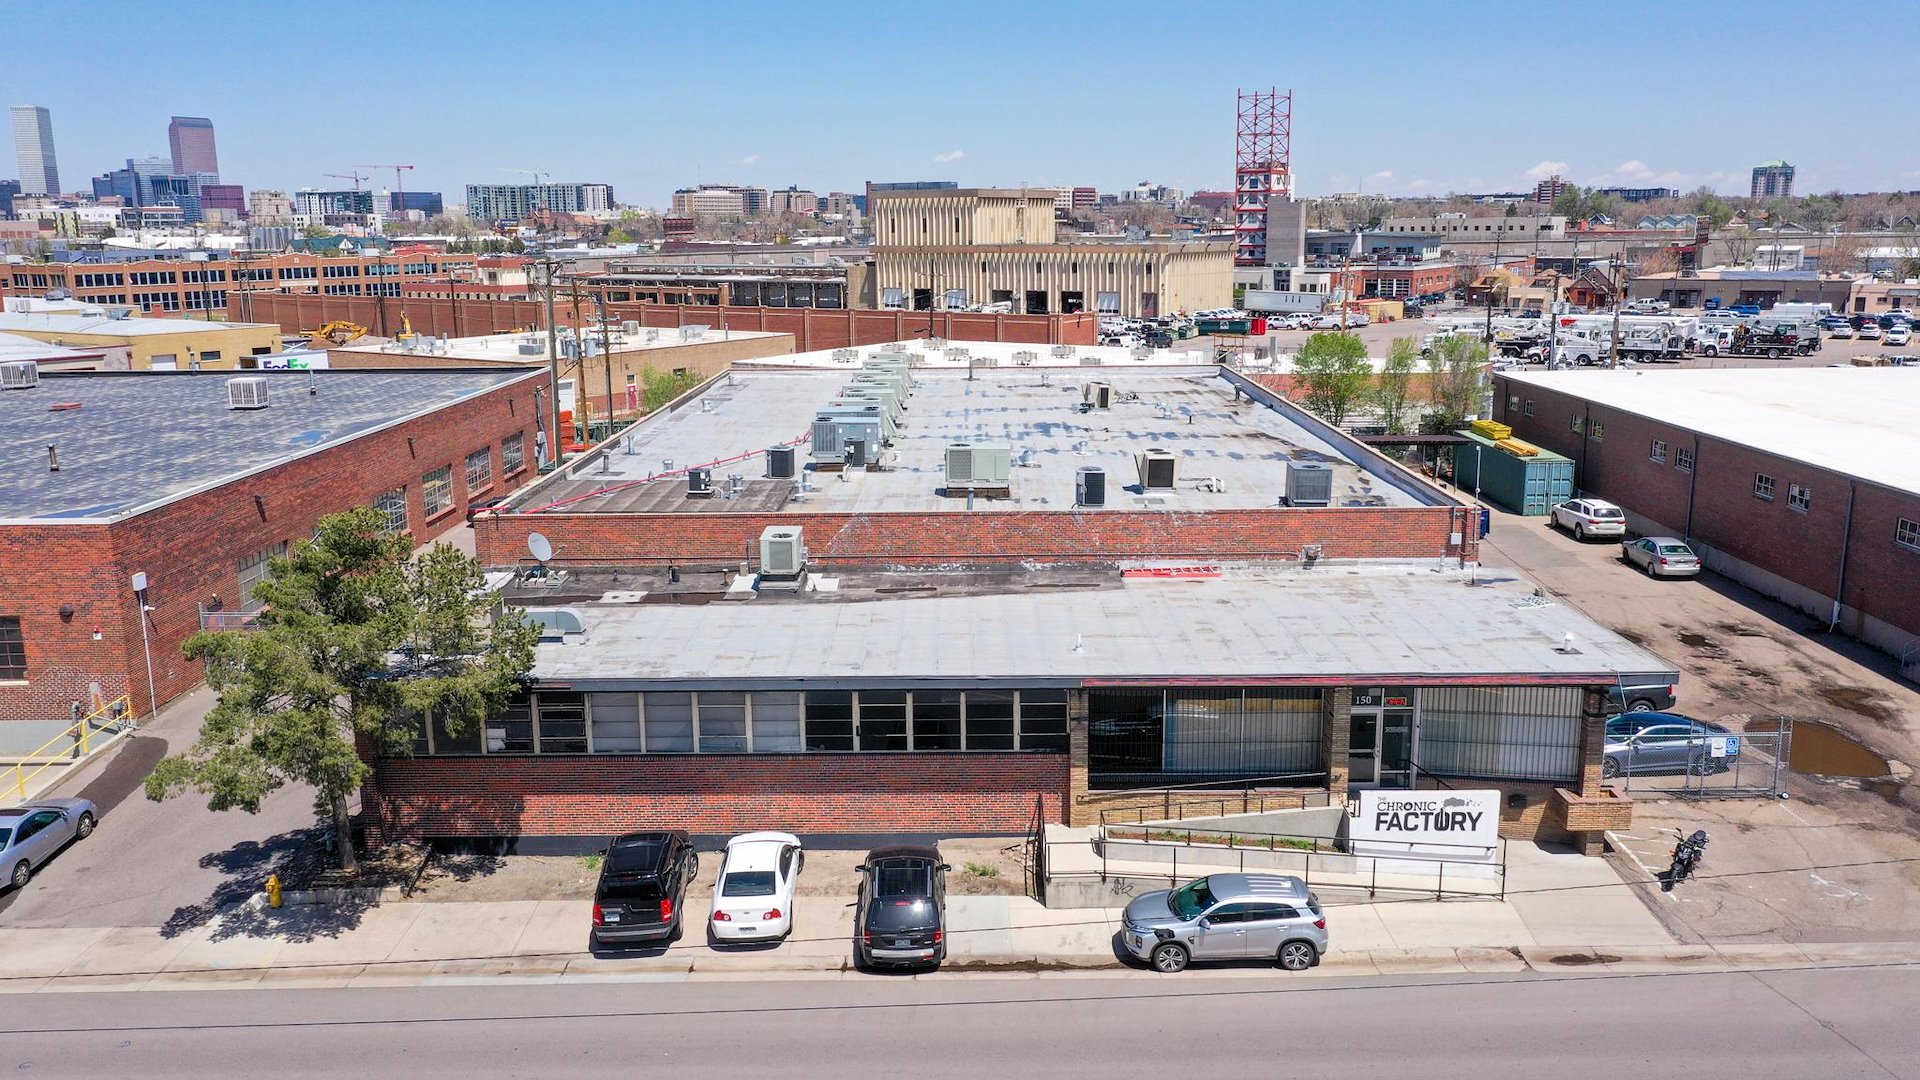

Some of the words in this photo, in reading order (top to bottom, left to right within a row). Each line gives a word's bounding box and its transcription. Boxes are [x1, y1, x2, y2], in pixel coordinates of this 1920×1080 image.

[1355, 696, 1372, 705] 150
[1377, 801, 1437, 812] CHRONIC
[1375, 811, 1484, 831] FACTORY
